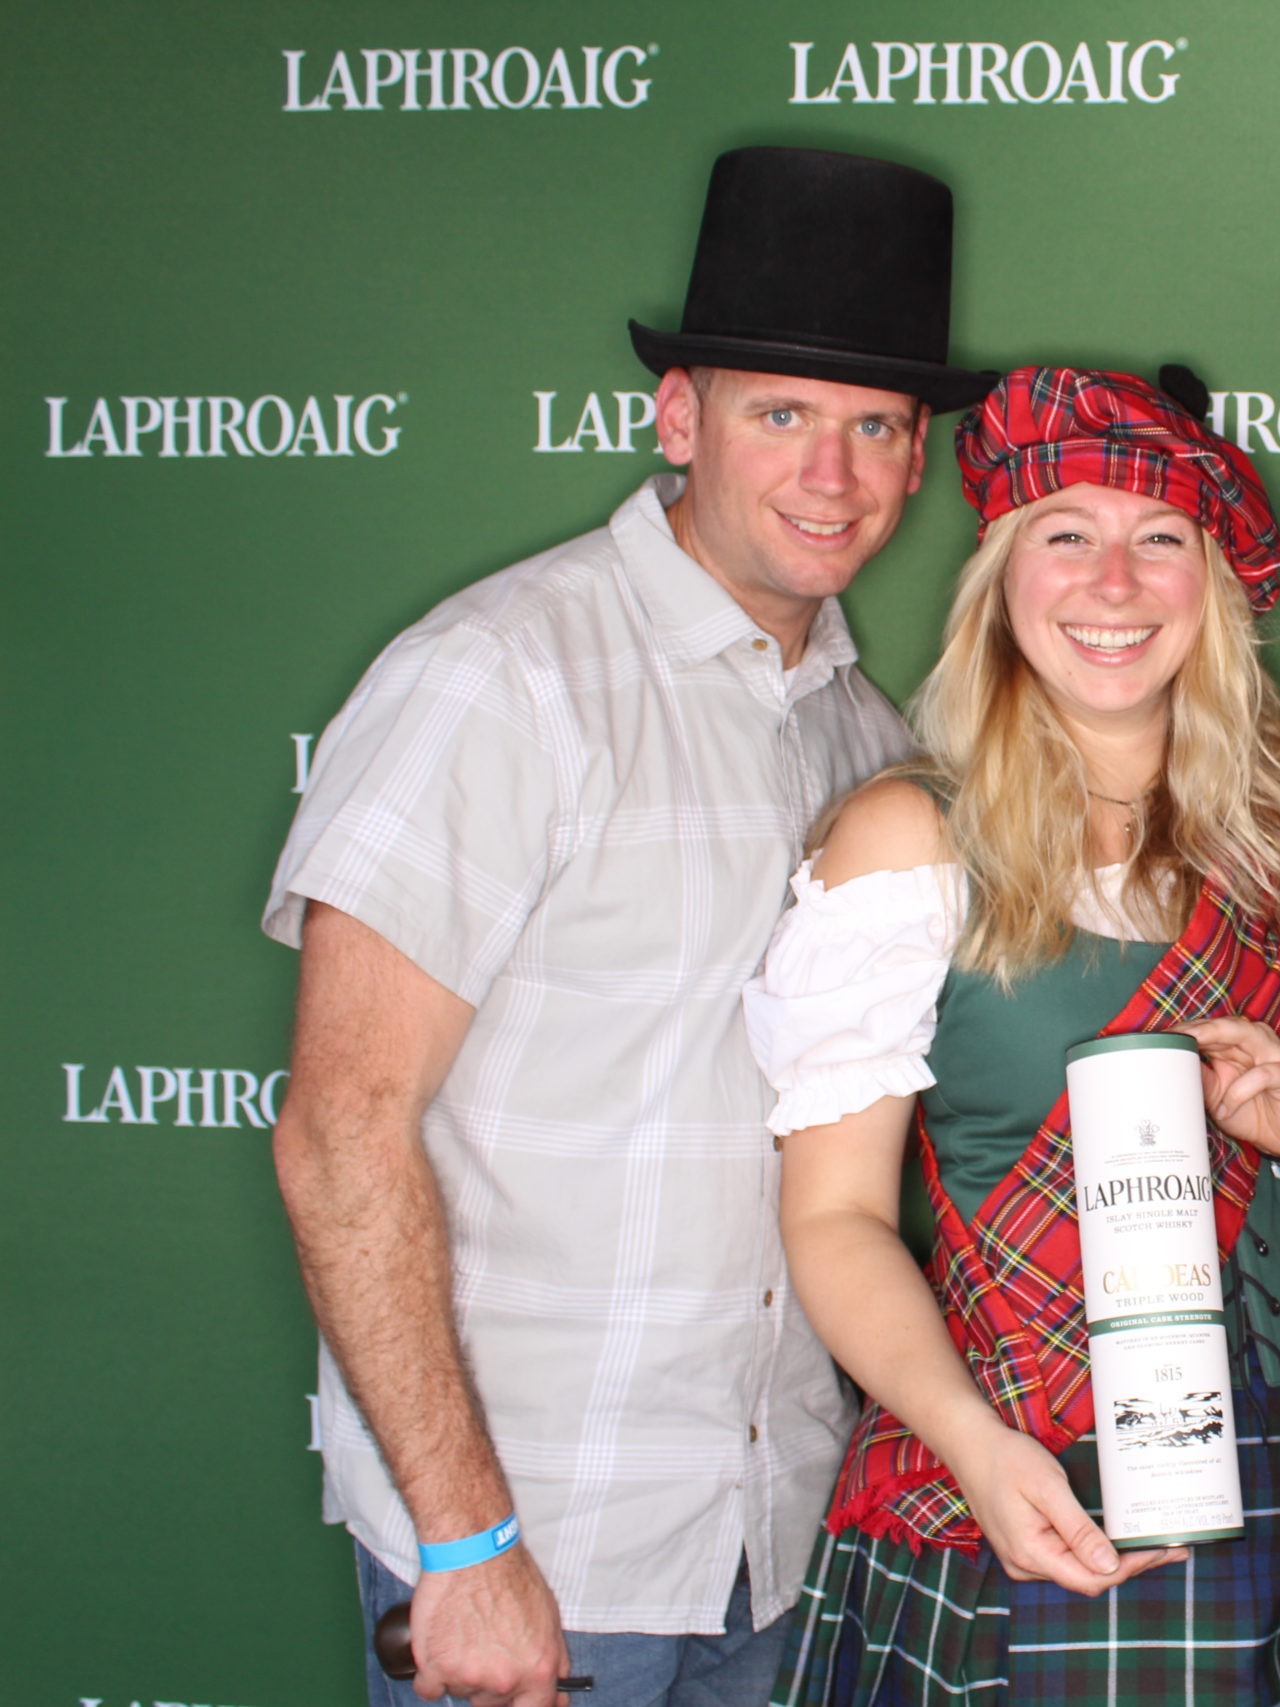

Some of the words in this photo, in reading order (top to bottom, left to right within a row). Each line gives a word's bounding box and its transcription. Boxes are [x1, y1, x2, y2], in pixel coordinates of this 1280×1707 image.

[281, 45, 652, 111] LAPHROAIG
[788, 39, 1181, 104] LAPHROAIG
[44, 394, 402, 458] LAPHROAIG
[532, 391, 663, 453] LAP
[1084, 1174, 1211, 1212] LAPHROAIG
[1106, 1213, 1133, 1224] ISLAY
[1136, 1209, 1174, 1219] SINGLE
[1176, 1208, 1198, 1217] MALT
[1113, 1222, 1152, 1234] SCOTCH
[1155, 1220, 1193, 1230] WHISKY
[1115, 1294, 1164, 1308] TRIPLE
[1168, 1292, 1204, 1303] WOOD
[1154, 1366, 1183, 1383] 1815
